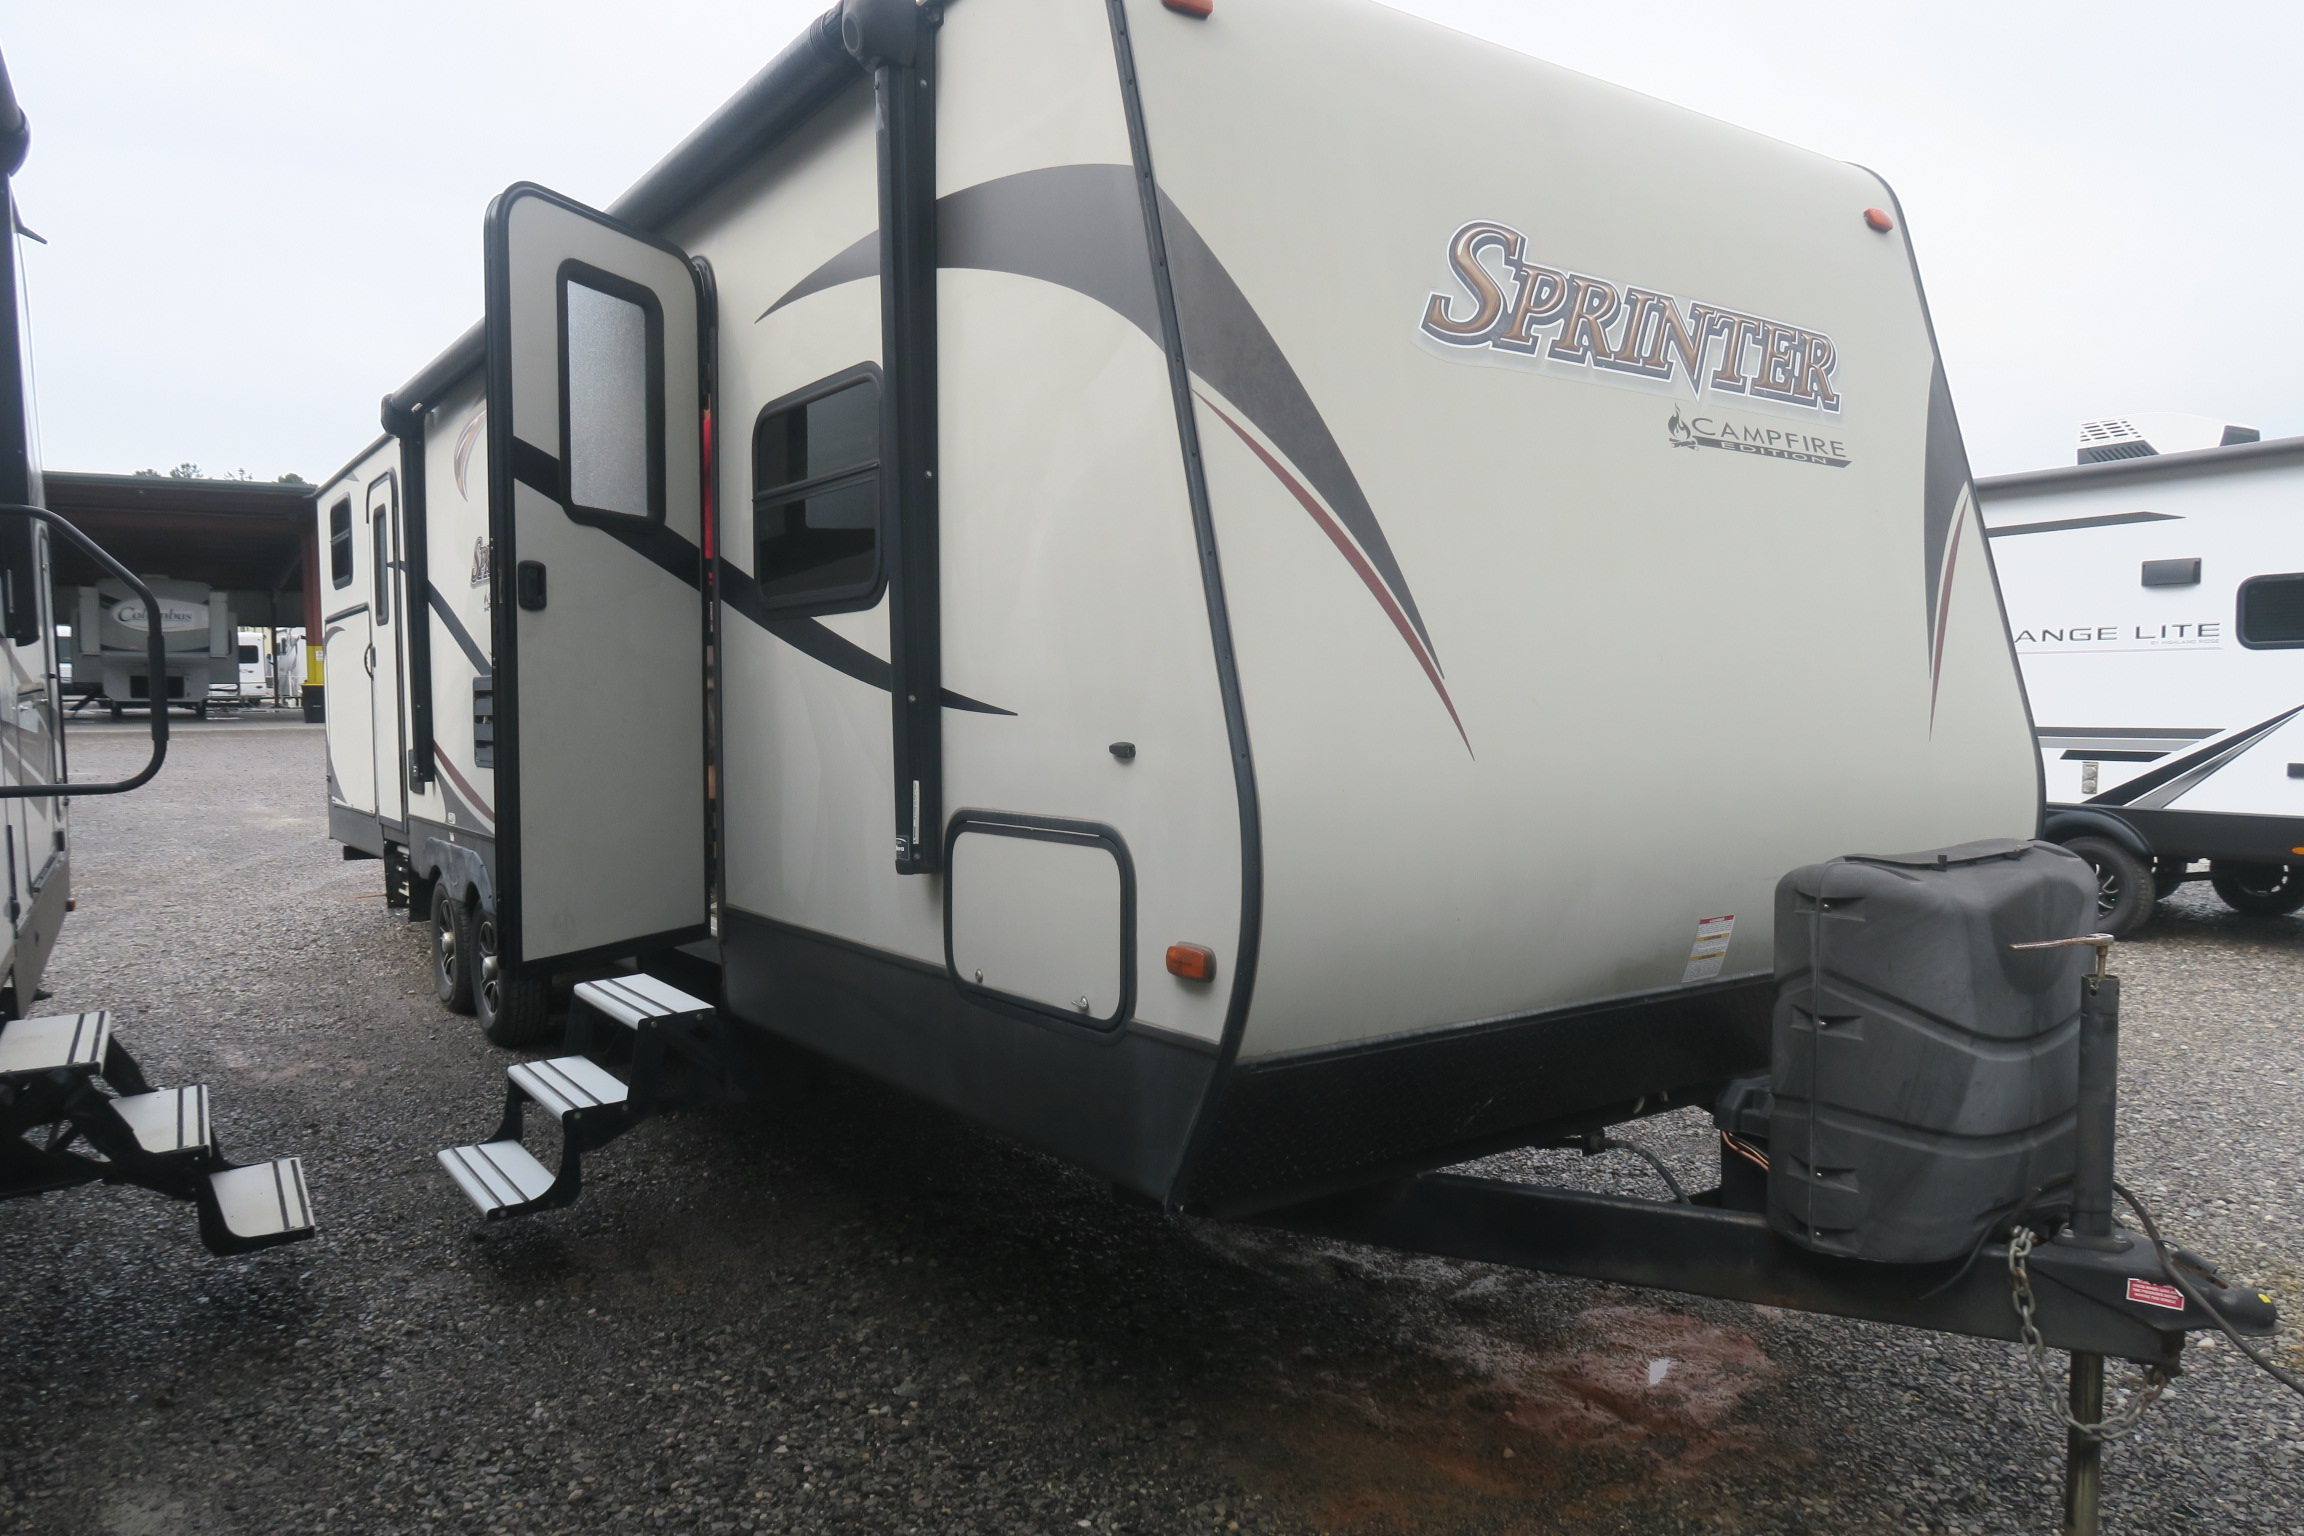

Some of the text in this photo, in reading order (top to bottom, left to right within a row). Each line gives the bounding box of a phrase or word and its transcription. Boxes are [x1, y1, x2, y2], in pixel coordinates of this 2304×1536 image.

[1419, 219, 1842, 415] SPRINTER
[1691, 417, 1847, 458] CAMPFIRE
[1720, 441, 1828, 465] EDITION
[2014, 622, 2221, 643] ANGE LITE
